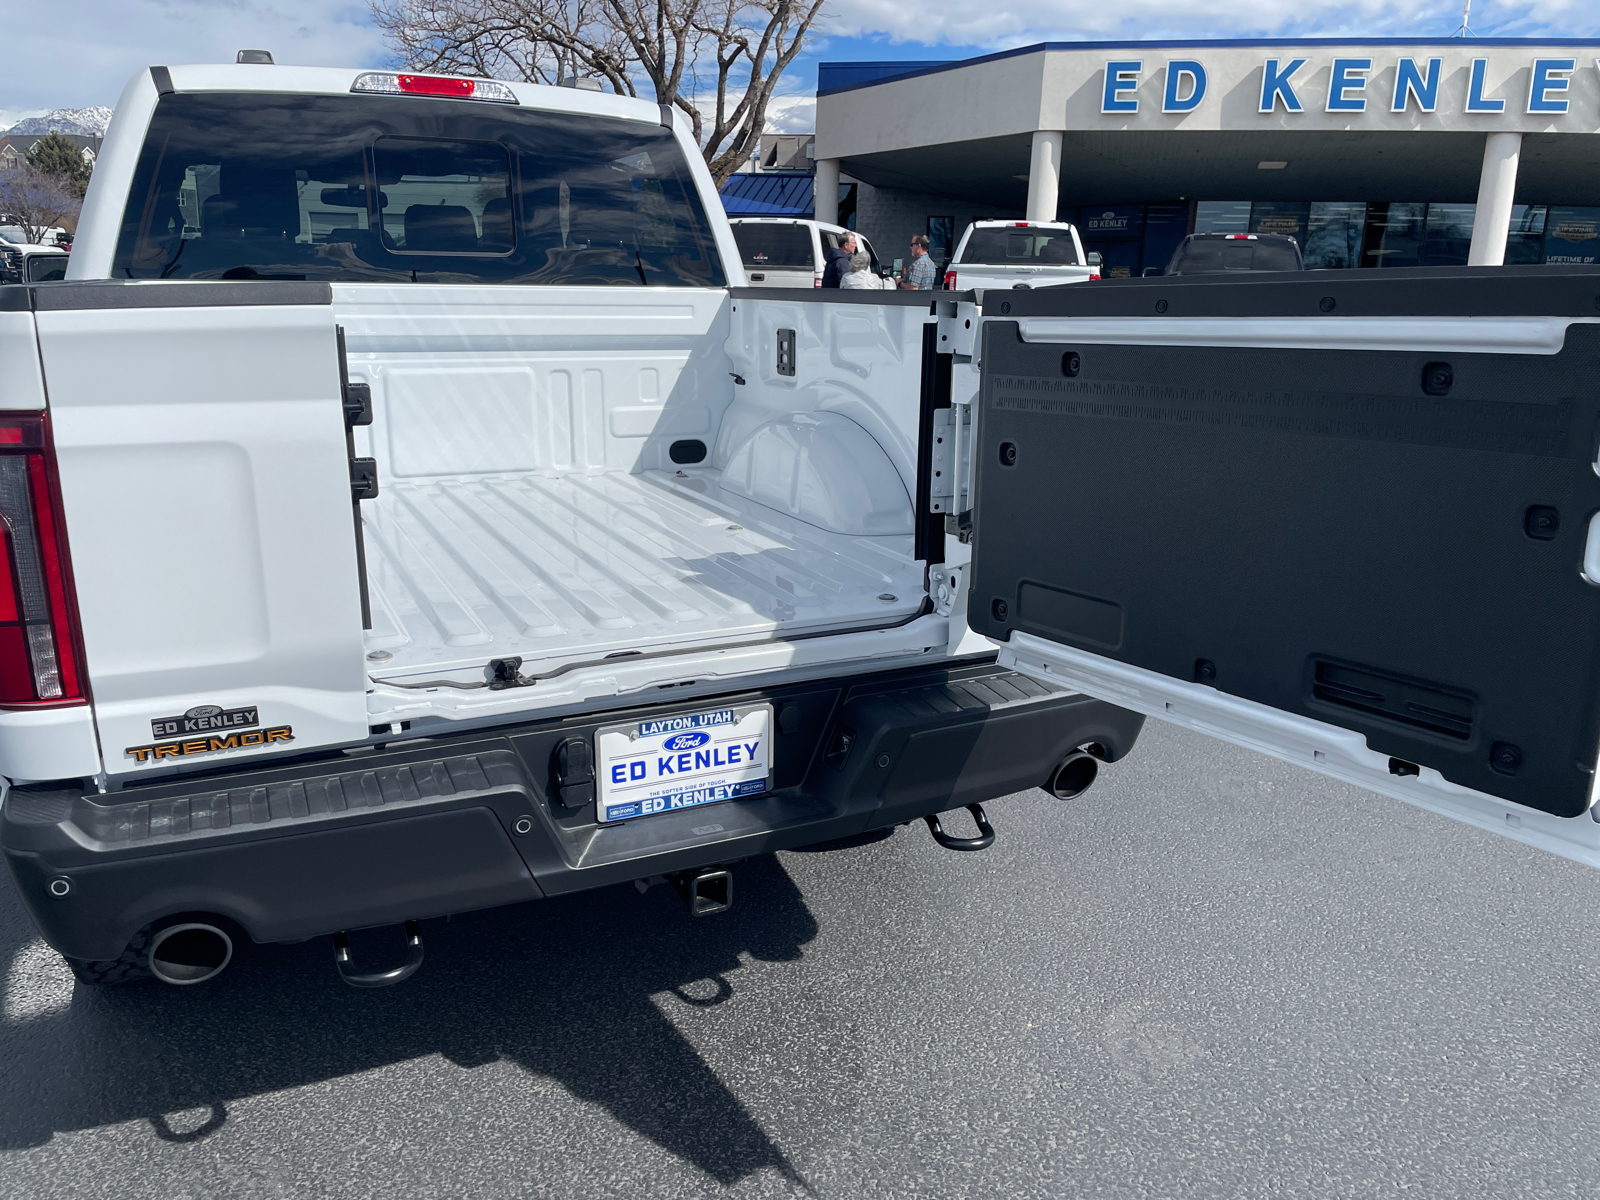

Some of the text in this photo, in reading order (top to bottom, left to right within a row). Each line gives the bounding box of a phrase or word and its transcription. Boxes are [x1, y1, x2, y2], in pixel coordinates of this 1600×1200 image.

[1100, 56, 1600, 116] ED KENLE
[1088, 219, 1128, 228] ED KENLEY
[152, 711, 256, 735] ED KENLEY
[193, 708, 214, 717] Ford
[641, 711, 731, 735] LAYTON, UTAH
[125, 725, 295, 762] TREMOR
[671, 733, 702, 750] Ford
[611, 741, 760, 784] ED KENLEY
[641, 798, 665, 814] ED
[670, 784, 735, 809] KENLEY
[661, 786, 683, 796] SOFTER
[684, 783, 698, 791] SIDE
